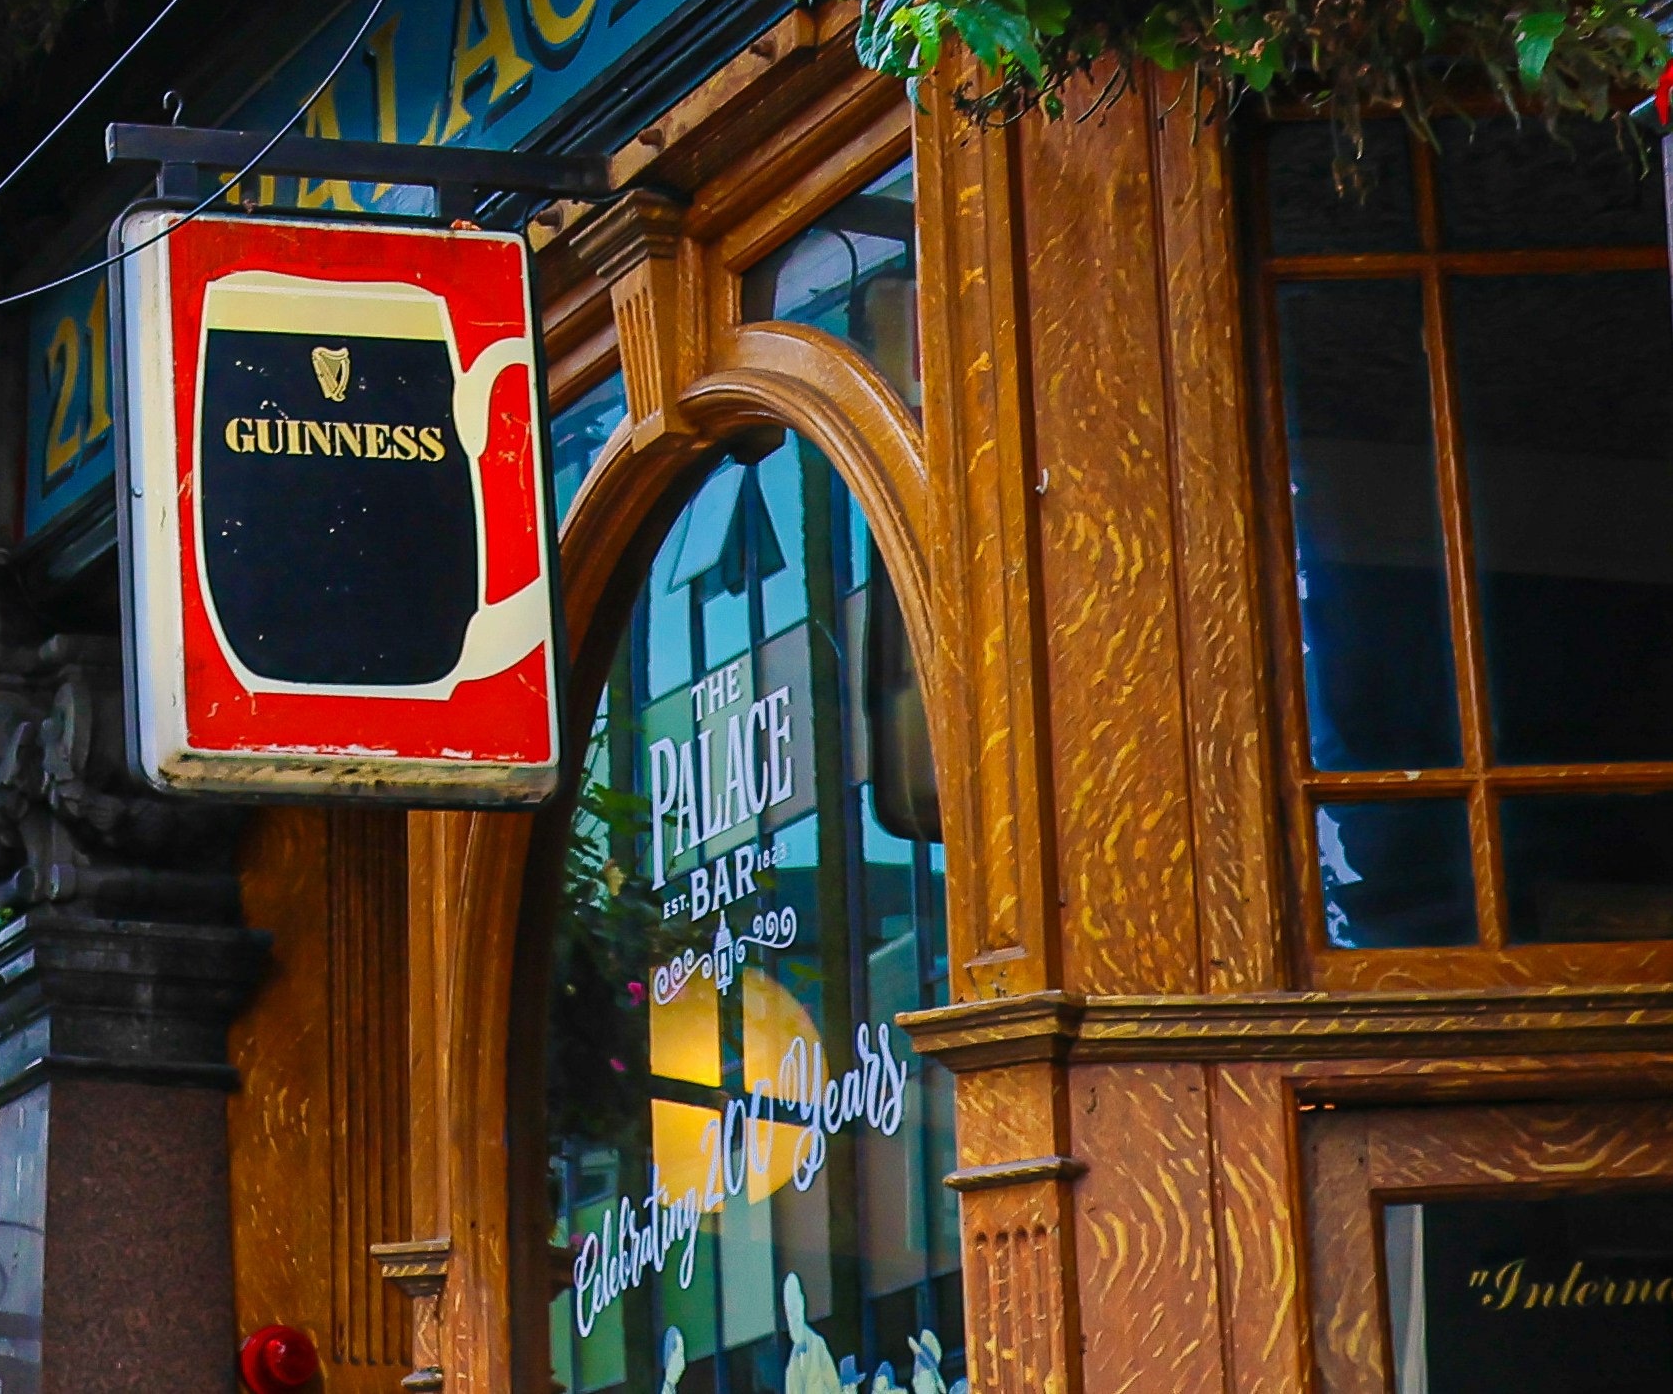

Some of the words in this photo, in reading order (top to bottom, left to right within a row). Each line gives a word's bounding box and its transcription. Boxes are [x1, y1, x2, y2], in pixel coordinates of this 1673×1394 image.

[45, 274, 114, 478] 21
[224, 415, 447, 463] GUINNESS
[690, 661, 743, 723] THE
[648, 685, 794, 892] PALACE
[662, 894, 691, 921] EST.
[690, 842, 757, 922] BAR
[756, 841, 789, 872] 1823
[573, 1182, 702, 1340] Celebrating
[701, 1079, 775, 1214] 200
[777, 1020, 908, 1194] Years
